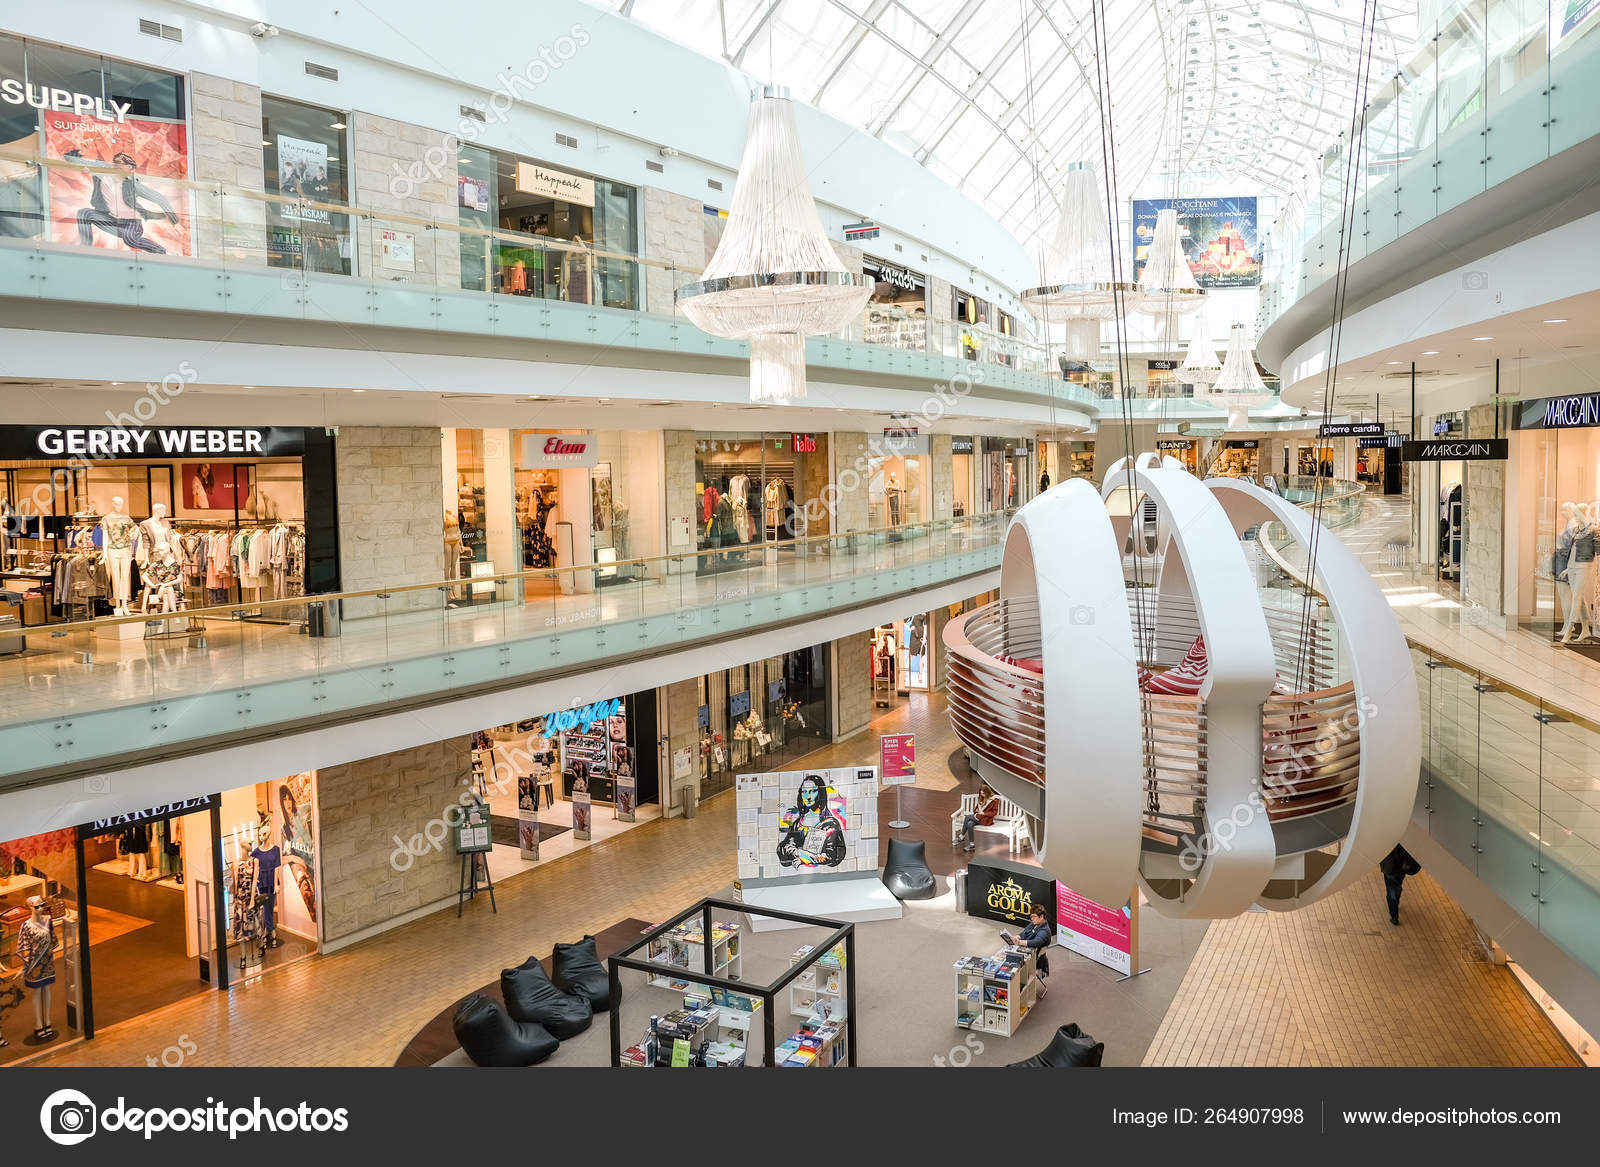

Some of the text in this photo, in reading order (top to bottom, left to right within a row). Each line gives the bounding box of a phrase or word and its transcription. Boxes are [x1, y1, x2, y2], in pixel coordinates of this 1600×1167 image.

[0, 79, 132, 124] SUPPLY
[54, 120, 121, 135] SUITSUPPLY
[535, 168, 581, 190] Happeak
[1323, 424, 1381, 435] pierre cardin
[37, 428, 263, 454] GERRY WEBER
[543, 436, 587, 455] Etam
[987, 883, 1032, 903] AROMA
[987, 894, 1032, 916] GOLD
[1102, 945, 1126, 963] EUROPA
